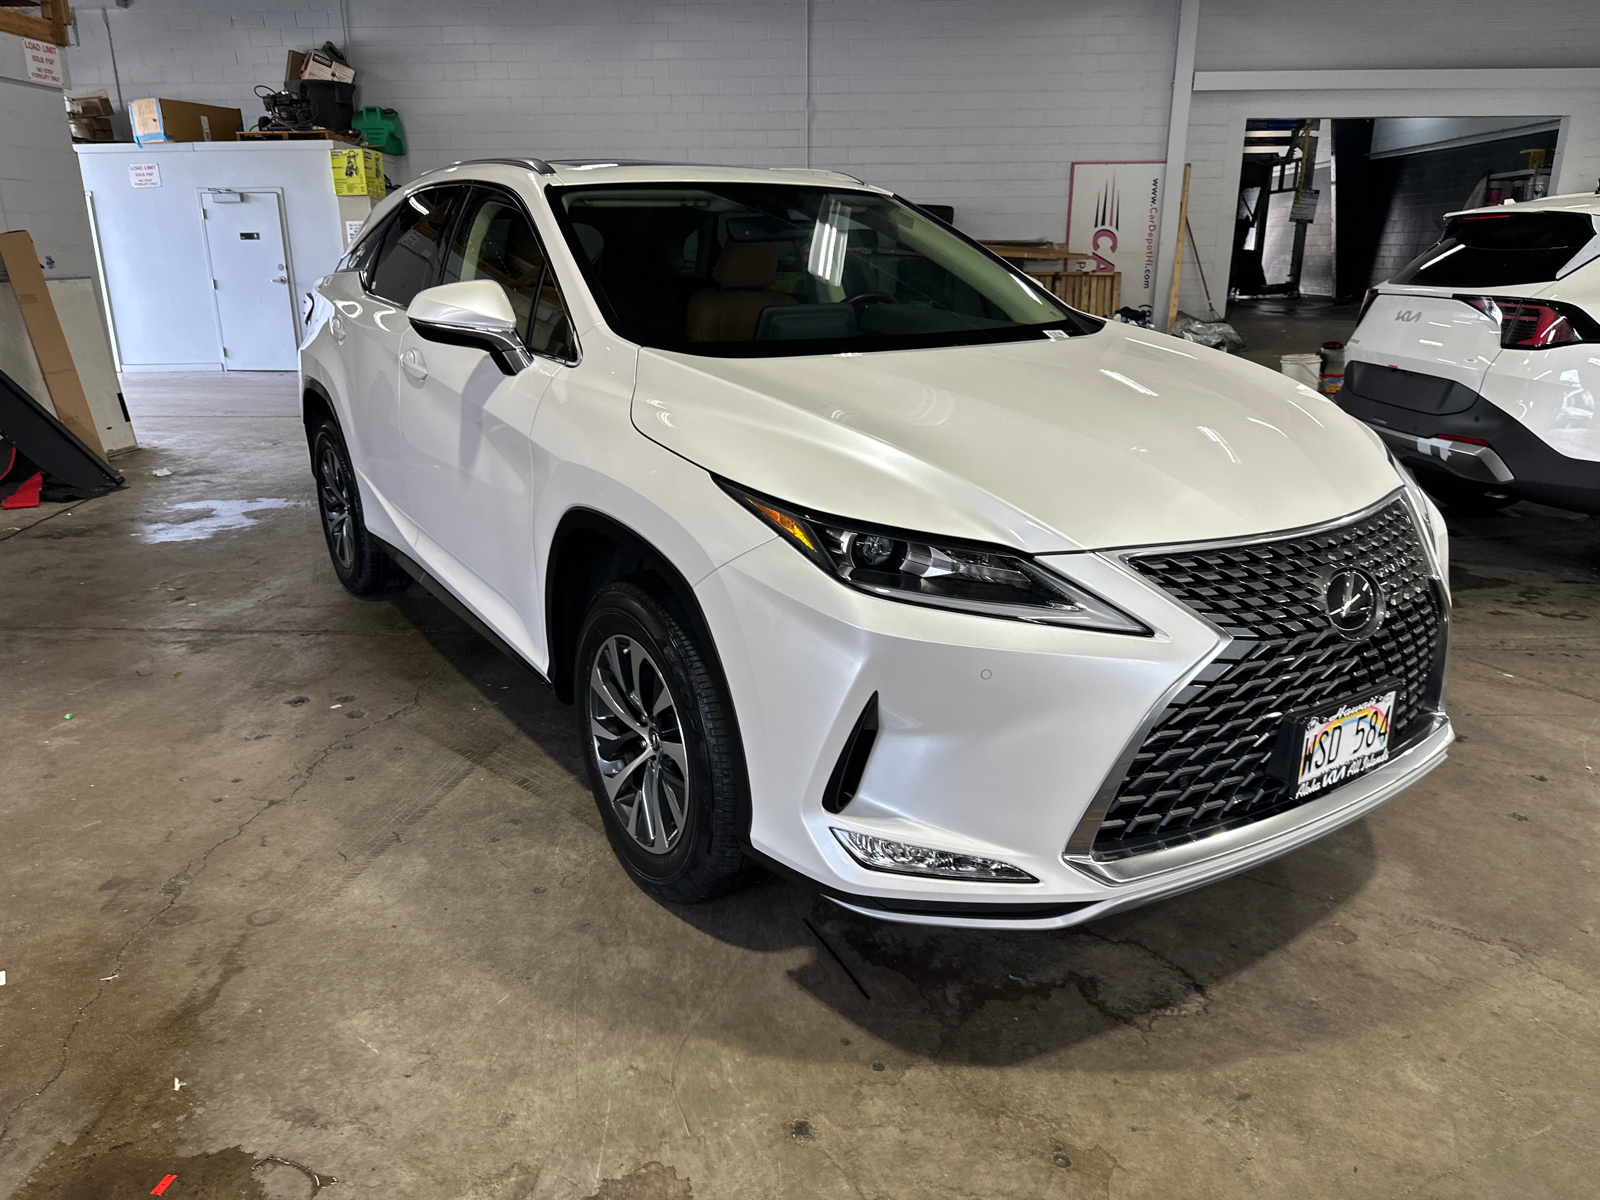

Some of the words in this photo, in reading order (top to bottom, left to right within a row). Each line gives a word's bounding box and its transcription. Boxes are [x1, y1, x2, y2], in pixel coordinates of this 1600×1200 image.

[24, 41, 41, 51] LOAD
[42, 45, 56, 54] LIMIT
[1092, 229, 1118, 273] CA
[1143, 178, 1158, 289] www.CarDepotHI.com
[1395, 310, 1422, 323] KIA
[1351, 705, 1391, 754] 584
[1322, 765, 1346, 788] KIA
[1346, 759, 1361, 777] All
